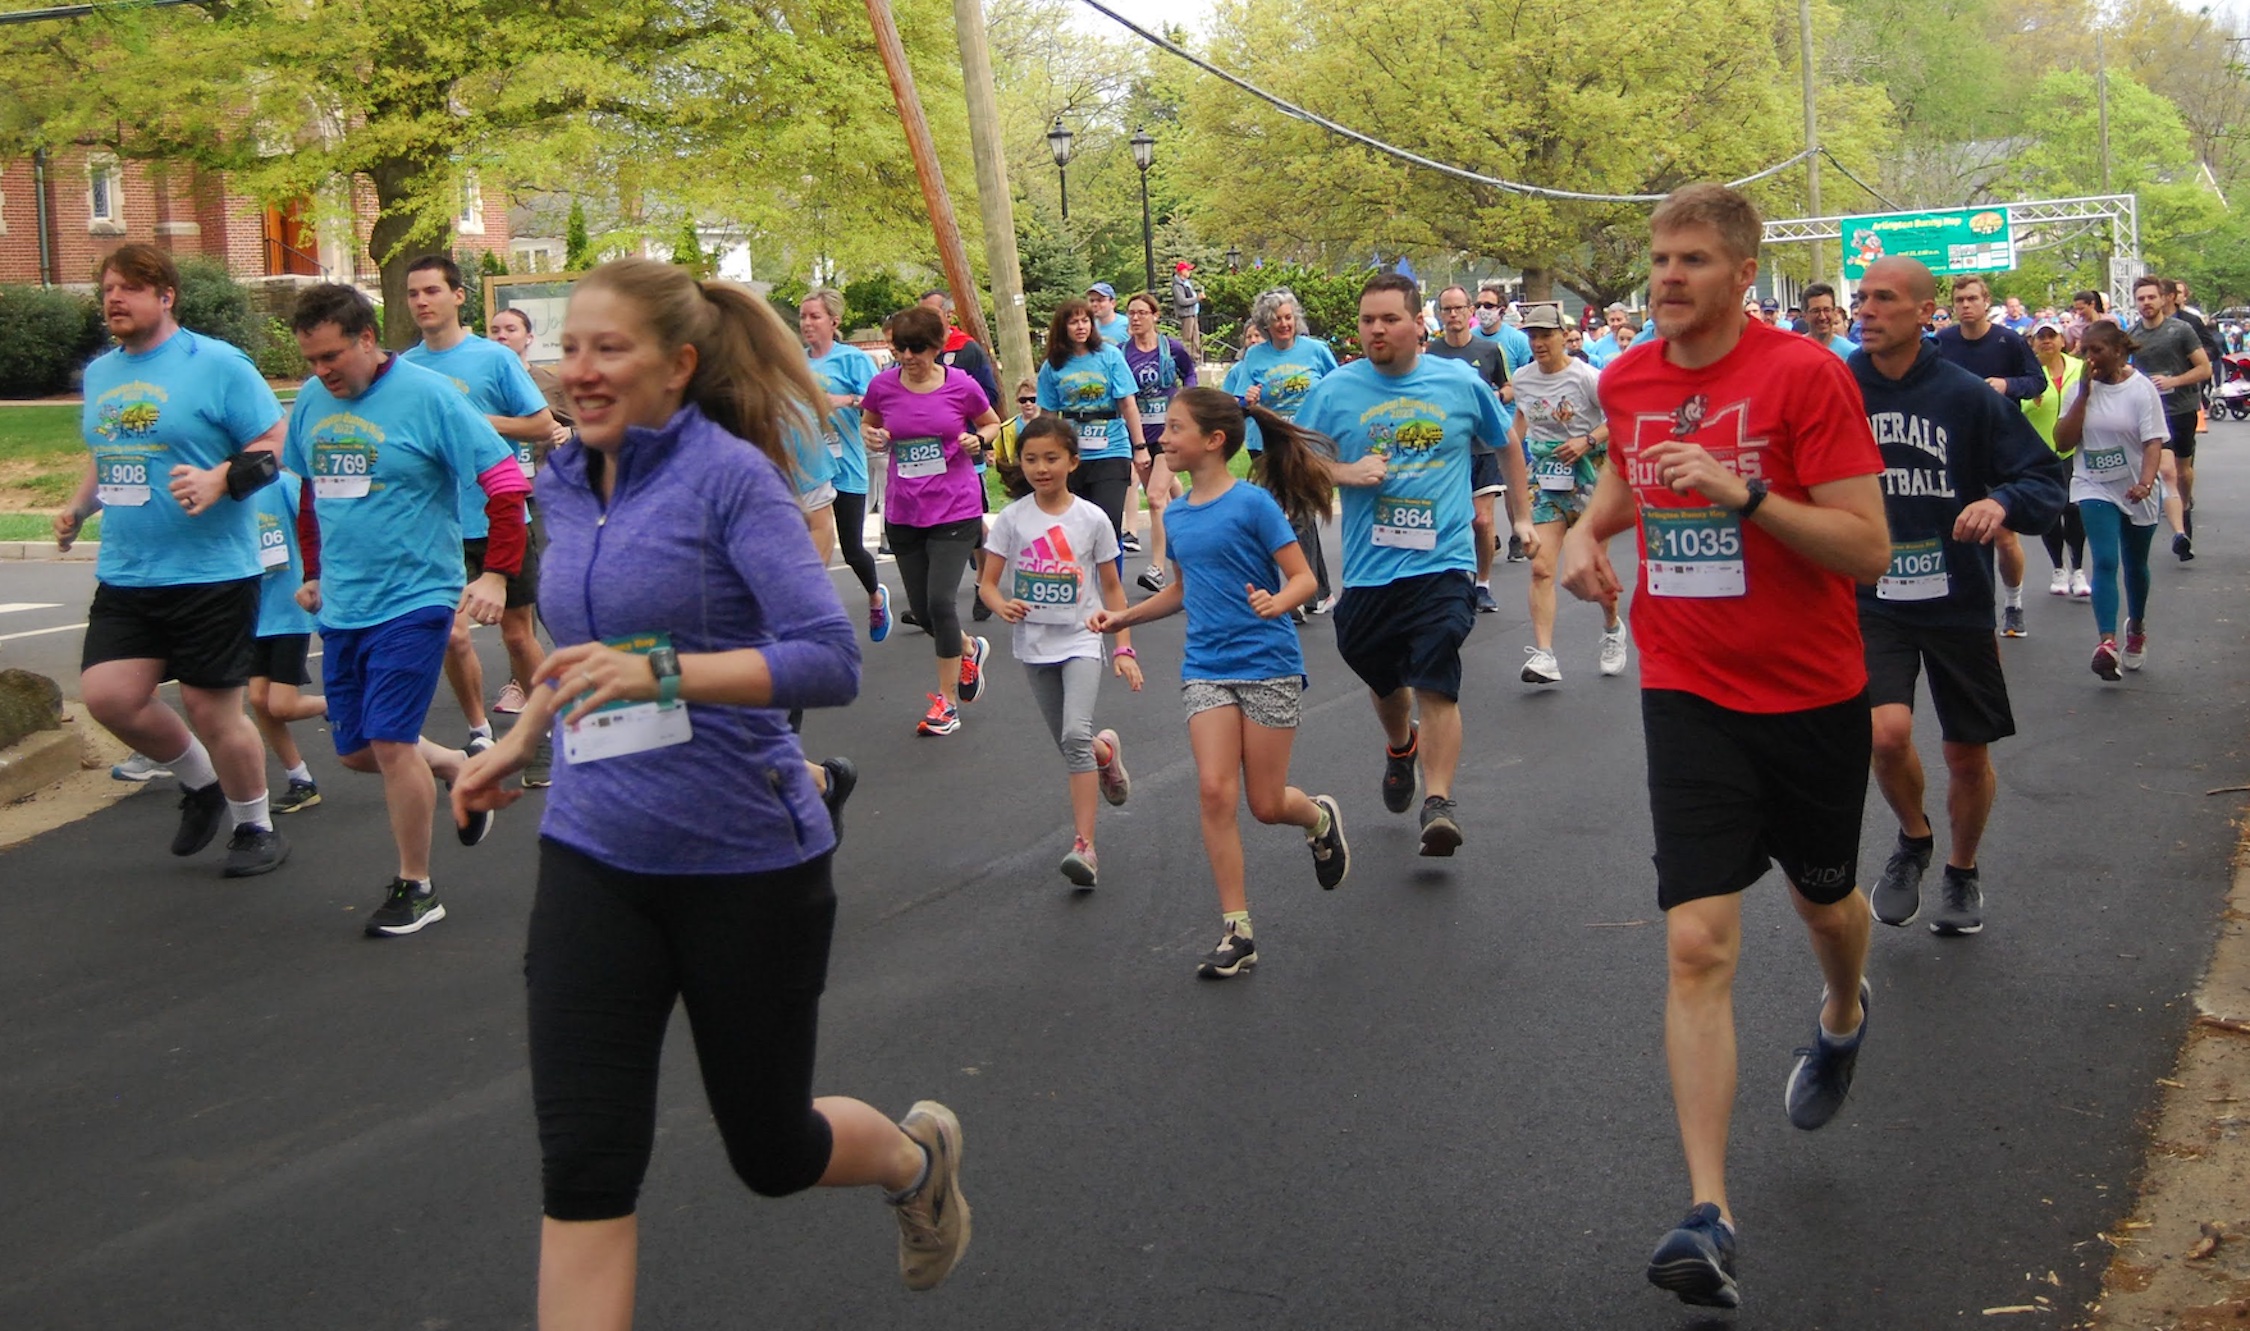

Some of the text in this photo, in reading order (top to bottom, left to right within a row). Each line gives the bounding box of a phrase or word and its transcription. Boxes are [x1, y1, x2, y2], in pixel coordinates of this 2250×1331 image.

[1148, 402, 1167, 414] 791
[1083, 425, 1107, 437] 877
[910, 443, 940, 461] 825
[2095, 452, 2124, 469] 888
[112, 464, 147, 483] 908
[330, 453, 367, 475] 769
[1545, 461, 1573, 476] 785
[1878, 467, 1956, 498] TBALL
[1393, 507, 1433, 528] 864
[1646, 509, 1728, 520] Arlington Bunny Hop
[262, 529, 284, 546] 06
[1665, 527, 1739, 557] 1035
[1893, 551, 1943, 575] 1067
[1032, 582, 1073, 603] 959
[1803, 861, 1848, 884] VIDA
